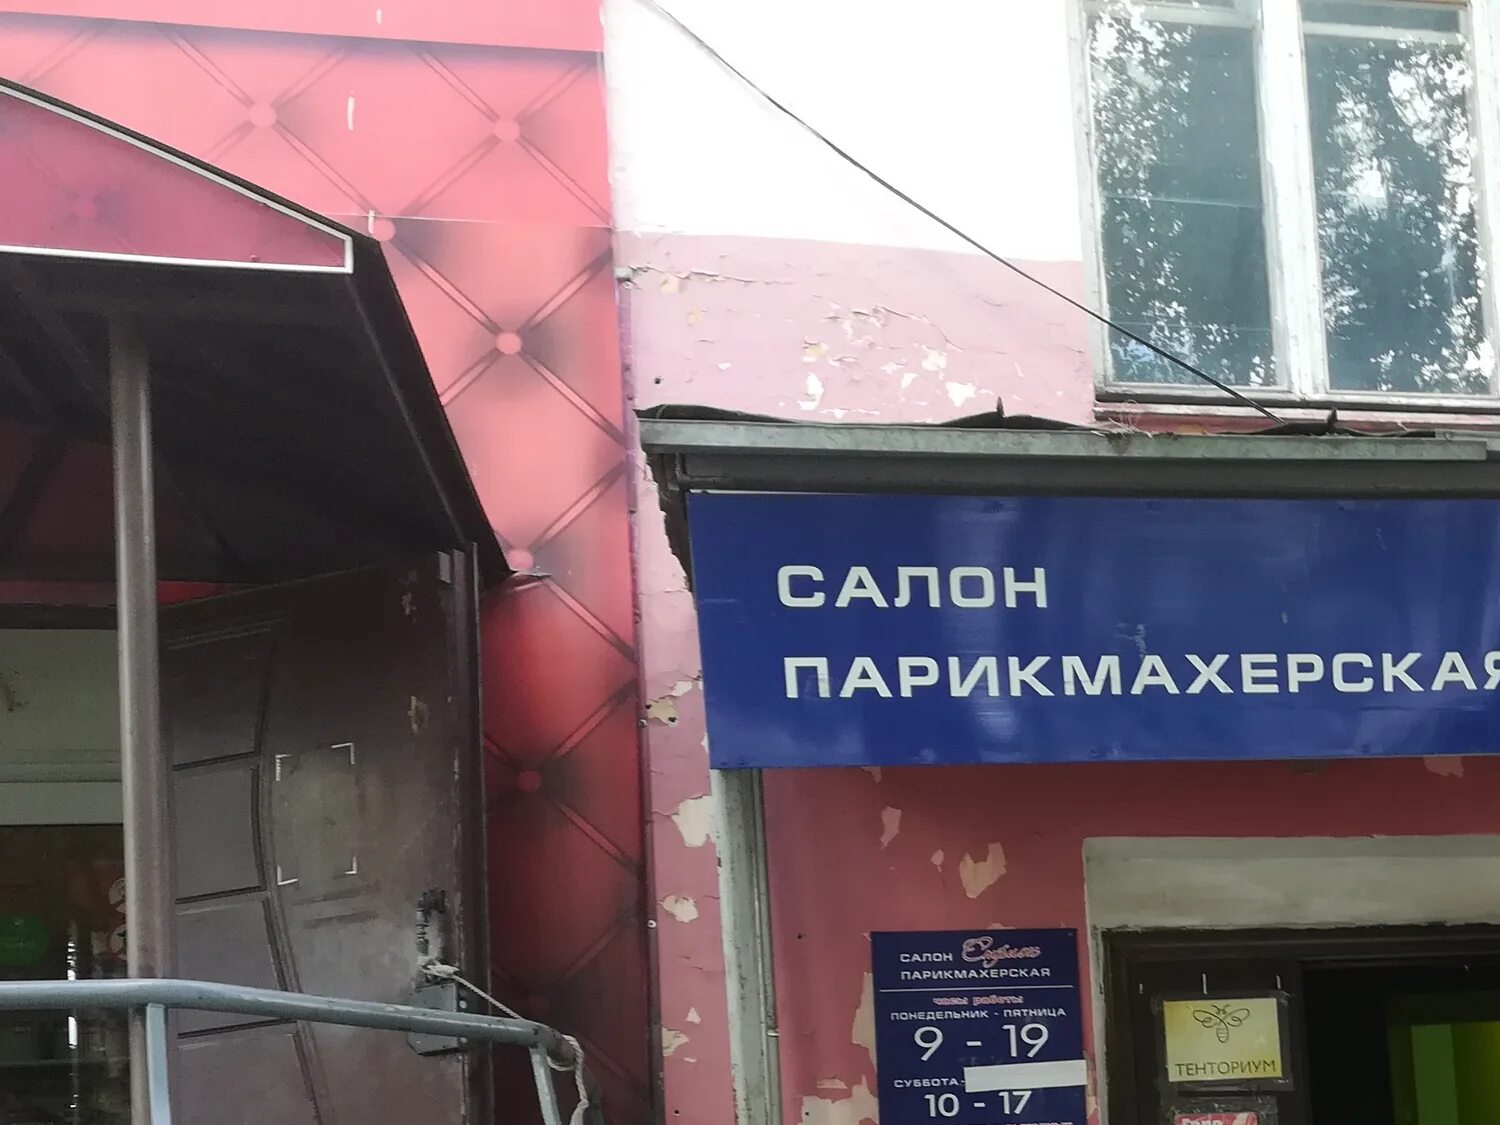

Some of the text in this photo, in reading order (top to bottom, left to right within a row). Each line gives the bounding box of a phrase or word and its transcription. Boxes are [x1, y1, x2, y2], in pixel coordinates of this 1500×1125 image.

[776, 564, 1048, 610] САЛОН
[900, 953, 953, 963] САЛОН
[901, 968, 1051, 980] ПАРИКМАХЕРСКАЯ
[891, 1010, 989, 1021] ПОНЕДЕЛЬНИК
[1004, 1008, 1066, 1018] ПЯТНИЦА
[914, 1026, 943, 1062] 9
[1002, 1023, 1049, 1058] 19
[1175, 1059, 1276, 1078] ТЕНТОРИУМ
[924, 1093, 960, 1118] 10
[999, 1090, 1032, 1115] 17
